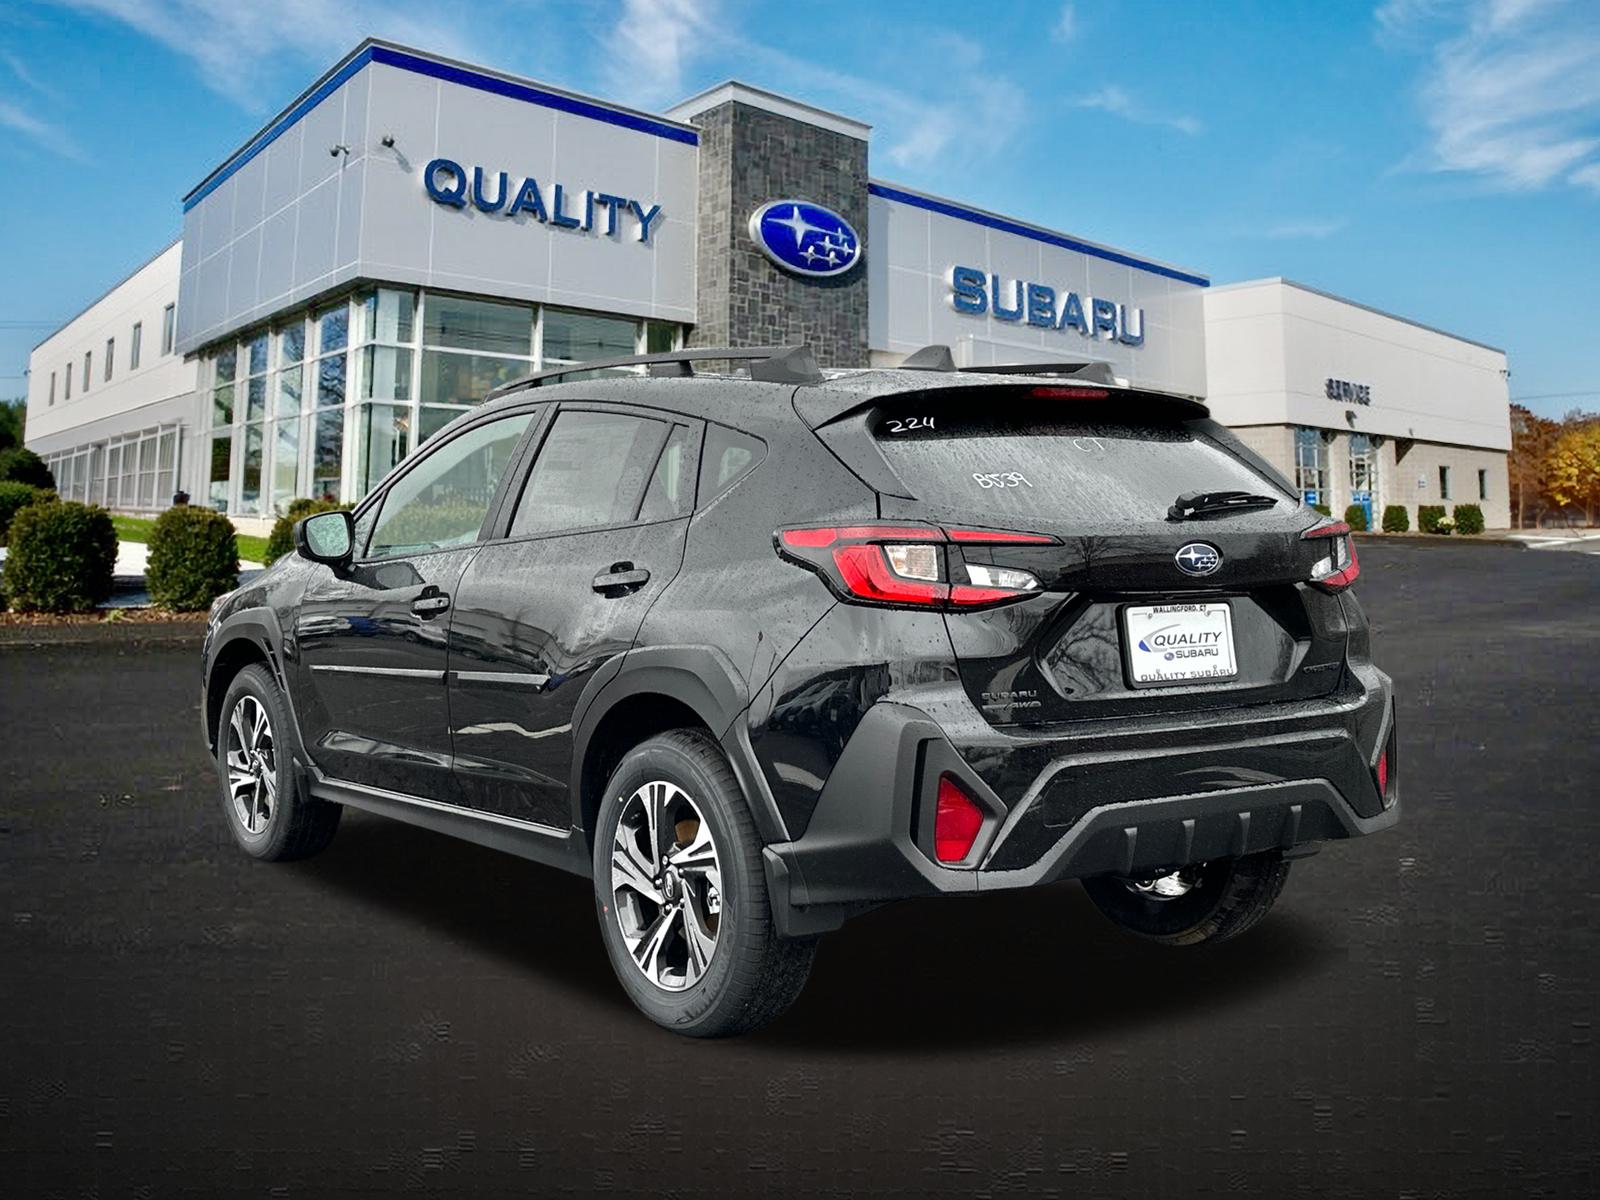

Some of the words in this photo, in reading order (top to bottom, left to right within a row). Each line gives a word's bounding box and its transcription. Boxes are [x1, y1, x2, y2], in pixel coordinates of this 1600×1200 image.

[424, 158, 661, 242] QUALITY
[951, 265, 1145, 346] SUBARU
[1325, 378, 1370, 407] SERVICE
[886, 416, 935, 433] 224
[1073, 436, 1105, 452] CT
[1154, 631, 1222, 647] QUALITY
[1175, 649, 1218, 658] SUBARU
[1140, 671, 1186, 681] QUALITY
[1190, 668, 1233, 678] SUBARU
[982, 690, 1037, 699] SUBARU
